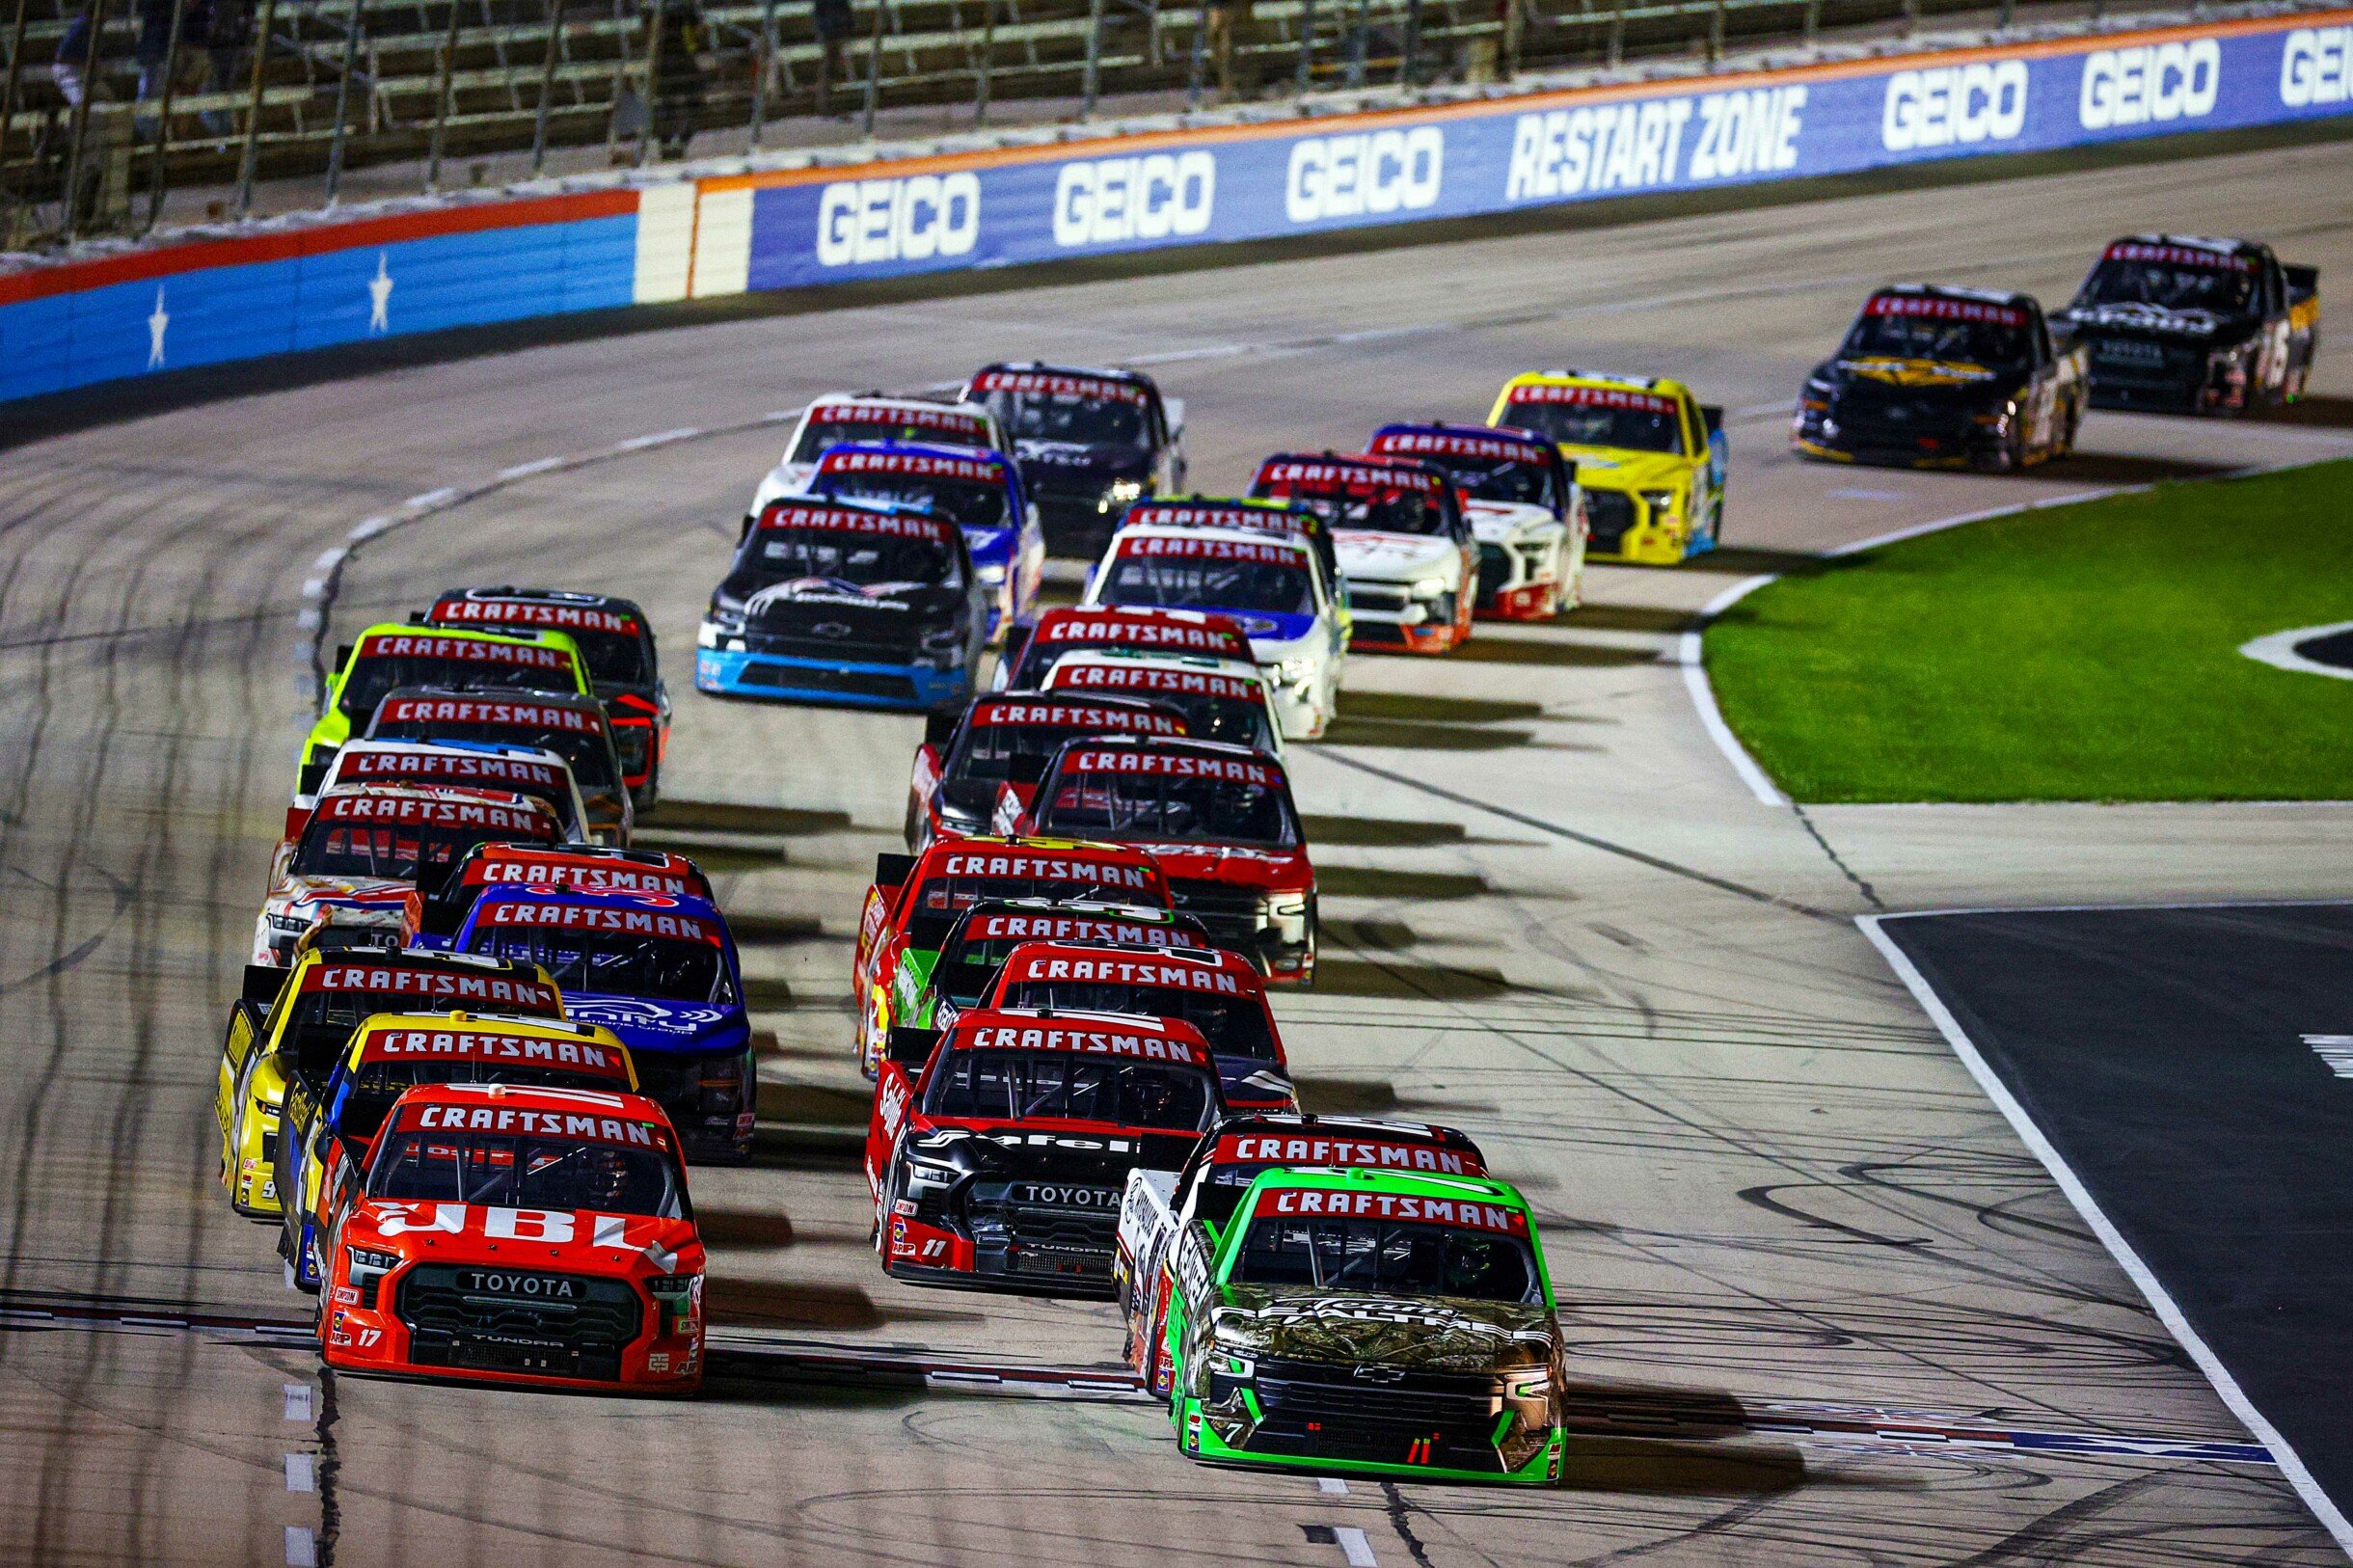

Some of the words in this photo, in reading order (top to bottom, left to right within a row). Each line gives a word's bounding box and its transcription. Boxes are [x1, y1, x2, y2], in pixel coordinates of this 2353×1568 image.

[2281, 26, 2353, 107] GEI
[2080, 38, 2220, 130] GEICO
[1881, 60, 2028, 151] GEICO
[1505, 97, 1692, 202] RESTART
[1690, 85, 1808, 181] ZONE
[1285, 124, 1443, 223] GEICO
[1053, 150, 1215, 247] GEICO
[817, 172, 981, 266] GEICO
[1514, 386, 1665, 412] CRAFTSMAN
[821, 407, 976, 431] CRAFTSMAN
[1383, 434, 1539, 462] CRAFTSMAN
[833, 455, 994, 479] CRAFTSMAN
[1270, 463, 1430, 489] CRAFTSMAN
[773, 508, 940, 539] CRAFTSMAN
[1139, 507, 1303, 531] CRAFTSMAN
[1129, 538, 1298, 565] CRAFTSMAN
[446, 602, 623, 631] CRAFTSMAN
[1050, 621, 1228, 650] CRAFTSMAN
[376, 636, 557, 667] CRAFTSMAN
[1069, 666, 1250, 698] CRAFTSMAN
[397, 701, 583, 730] CRAFTSMAN
[989, 706, 1174, 735] CRAFTSMAN
[358, 753, 553, 784] CRAFTSMAN
[1079, 751, 1268, 783] CRAFTSMAN
[335, 798, 531, 830] CRAFTSMAN
[482, 863, 686, 895] CRAFTSMAN
[946, 855, 1145, 888] CRAFTSMAN
[495, 905, 703, 939] CRAFTSMAN
[987, 917, 1191, 946] CRAFTSMAN
[323, 968, 537, 1005] CRAFTSMAN
[1027, 960, 1237, 993] CRAFTSMAN
[384, 1032, 606, 1068] CRAFTSMAN
[973, 1028, 1192, 1062] CRAFTSMAN
[419, 1106, 652, 1146] CRAFTSMAN
[1236, 1139, 1463, 1175] CRAFTSMAN
[1026, 1185, 1122, 1207] TOYOTA
[1277, 1192, 1509, 1230] CRAFTSMAN
[367, 1202, 678, 1273] JBL
[922, 1239, 947, 1257] 11
[471, 1273, 573, 1297] TOYOTA
[358, 1329, 382, 1347] 17
[472, 1334, 564, 1347] TUNDRA
[1224, 1421, 1244, 1444] 7
